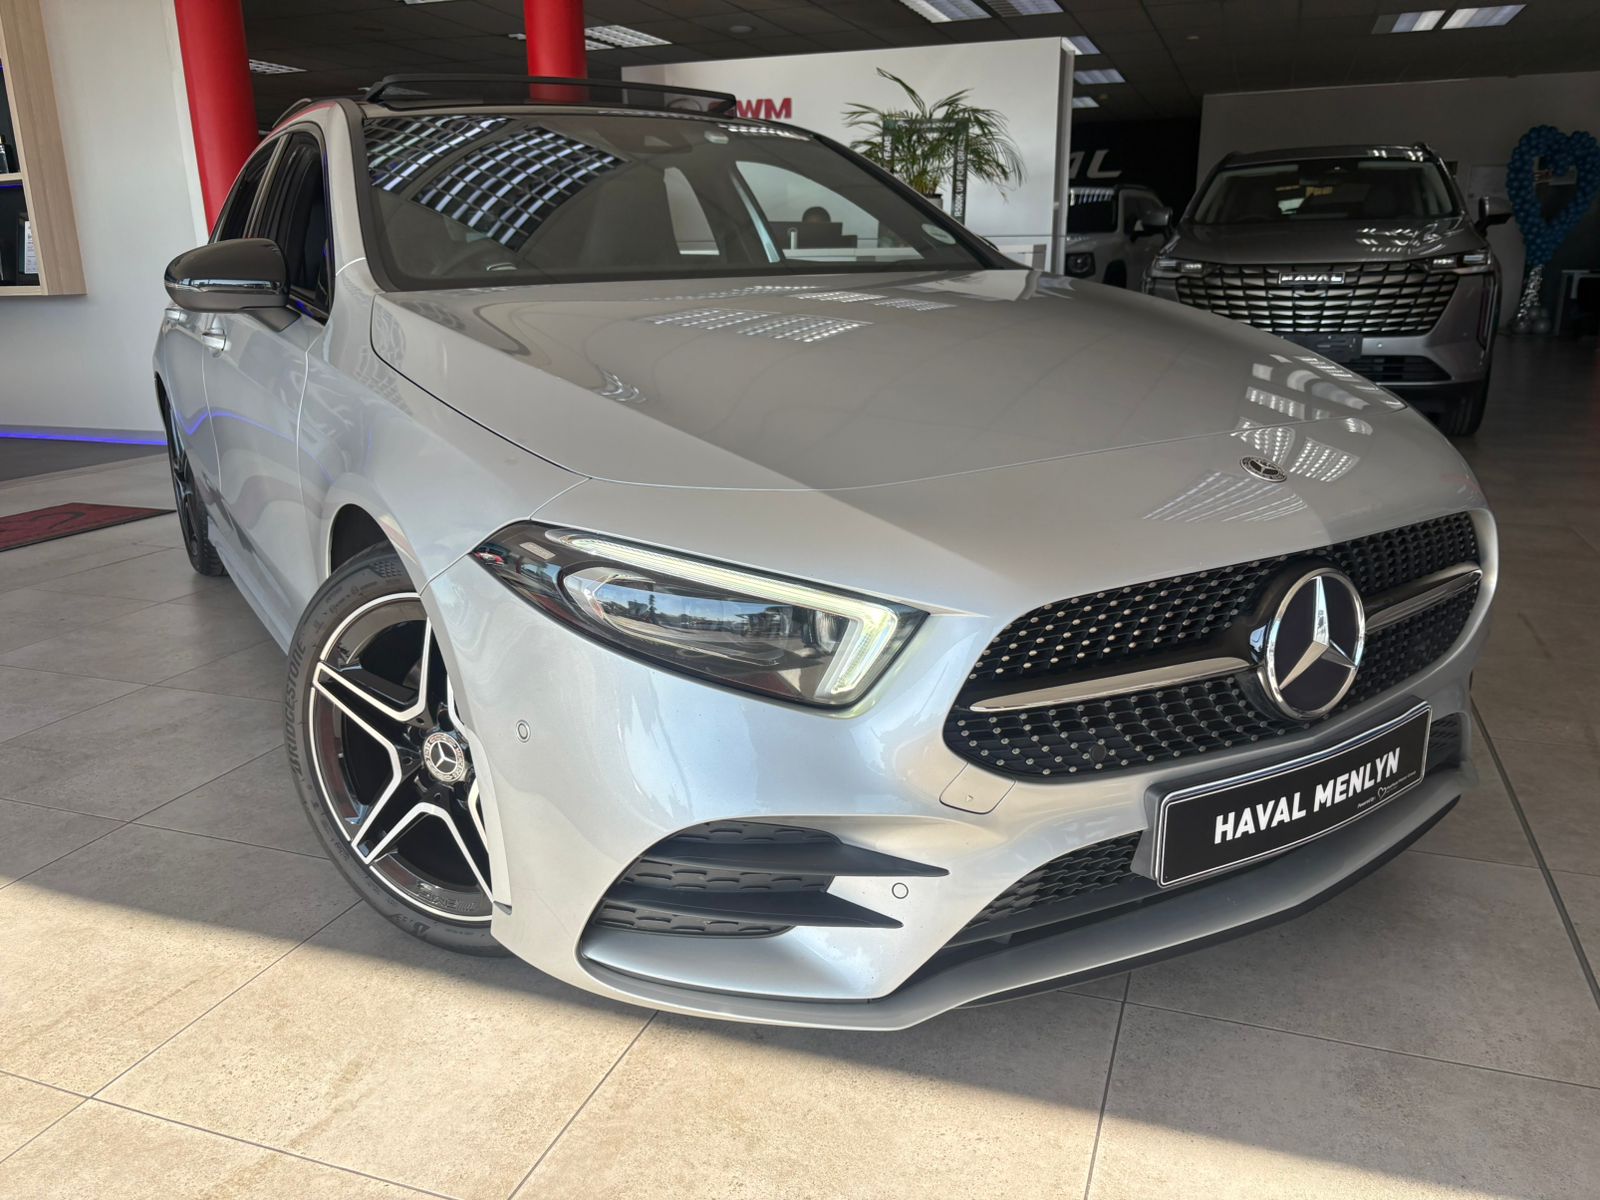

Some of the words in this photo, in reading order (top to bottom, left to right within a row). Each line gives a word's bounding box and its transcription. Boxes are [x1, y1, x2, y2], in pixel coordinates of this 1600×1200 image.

[955, 181, 965, 192] UP
[956, 163, 966, 180] FOR
[284, 640, 306, 777] BRIDGESTONE
[1214, 792, 1306, 845] HAVAL
[1313, 747, 1400, 812] MENLYN
